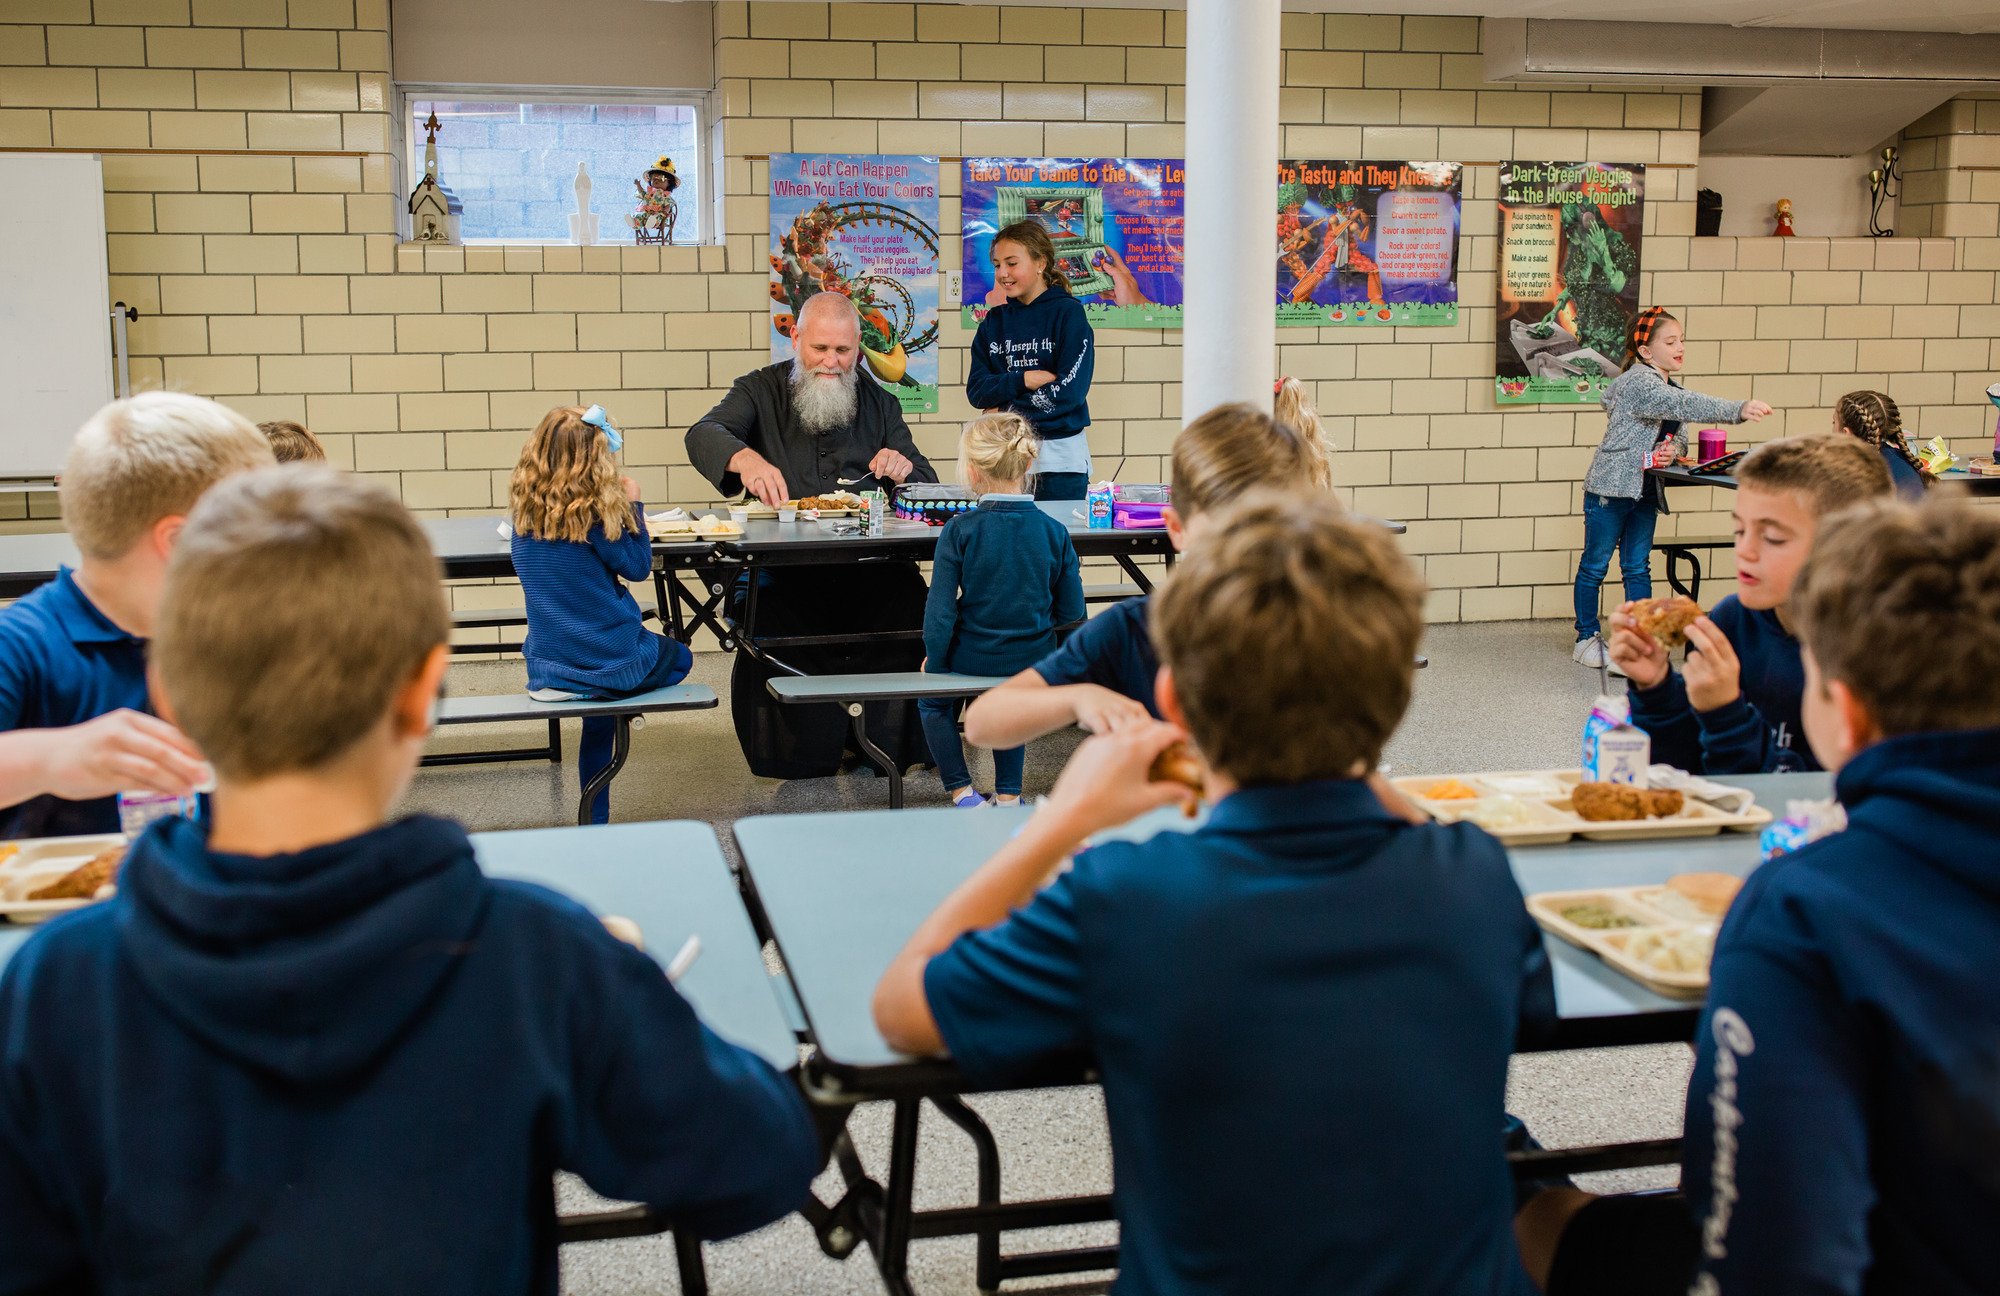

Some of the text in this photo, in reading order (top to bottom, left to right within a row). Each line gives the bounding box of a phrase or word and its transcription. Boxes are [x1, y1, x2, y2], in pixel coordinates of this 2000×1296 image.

[800, 160, 909, 180] A Lot Can Happen
[968, 163, 1001, 182] Take
[1004, 164, 1036, 182] Your
[1038, 163, 1079, 182] Game
[1082, 164, 1098, 182] to
[1102, 163, 1127, 183] the
[1299, 163, 1337, 190] Tasty
[1339, 165, 1363, 185] and
[1366, 165, 1398, 190] They
[1400, 165, 1436, 186] Know
[1512, 164, 1632, 188] Dark-Green Veggies
[774, 180, 934, 198] When You Eat Your Colors
[1124, 188, 1136, 196] Get
[1508, 186, 1636, 208] in the House Tonight!
[1138, 198, 1176, 208] your colors!
[1116, 216, 1139, 224] Choose
[1140, 216, 1160, 224] fruits
[1392, 212, 1413, 220] Crunch
[1512, 212, 1524, 220] Add
[1524, 212, 1547, 224] spinach
[1123, 226, 1131, 234] at
[1132, 226, 1152, 234] meals
[1153, 227, 1164, 235] and
[1382, 226, 1400, 234] Savor
[1426, 227, 1448, 236] potato.
[1511, 222, 1553, 231] your sandwich.
[840, 234, 904, 245] Make half your plate
[853, 245, 910, 256] fruits and veggies.
[1128, 244, 1149, 254] They'll
[1150, 244, 1162, 254] help
[1388, 242, 1404, 250] Rock
[1406, 243, 1420, 252] your
[860, 256, 918, 266] They'll help you eat
[1125, 255, 1140, 264] your
[1142, 254, 1157, 262] best
[1158, 254, 1166, 262] at
[1378, 250, 1401, 259] Choose
[1402, 252, 1437, 262] dark-green,
[1512, 254, 1527, 262] Make
[1532, 254, 1549, 262] salad.
[1394, 262, 1416, 270] orange
[1417, 262, 1438, 270] veggies
[1440, 261, 1446, 269] at
[873, 266, 933, 276] smart to play hard!
[1517, 272, 1530, 280] your
[1508, 280, 1528, 290] They're
[989, 338, 1056, 356] St. Joseph th
